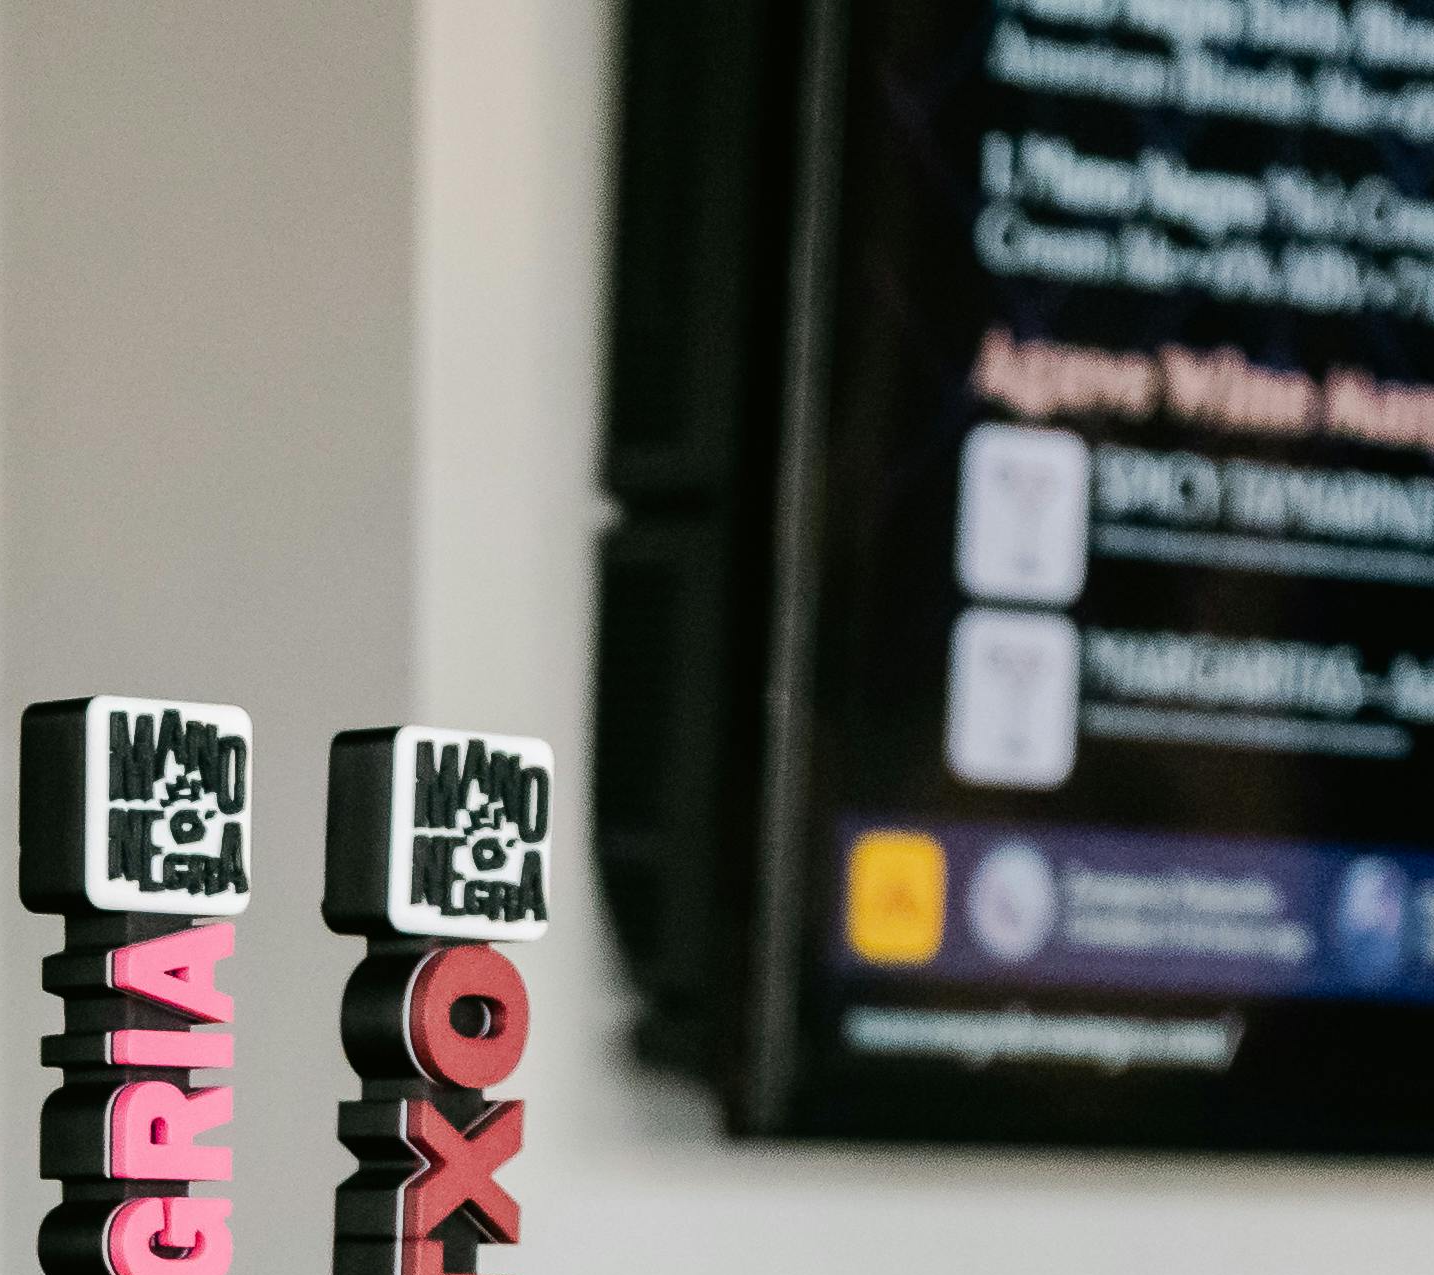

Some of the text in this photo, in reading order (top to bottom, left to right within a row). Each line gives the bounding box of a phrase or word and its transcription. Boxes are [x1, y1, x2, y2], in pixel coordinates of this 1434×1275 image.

[108, 708, 247, 815] MANO
[412, 738, 550, 844] MANO
[107, 808, 250, 897] NEGRA
[410, 835, 549, 923] NEGRA
